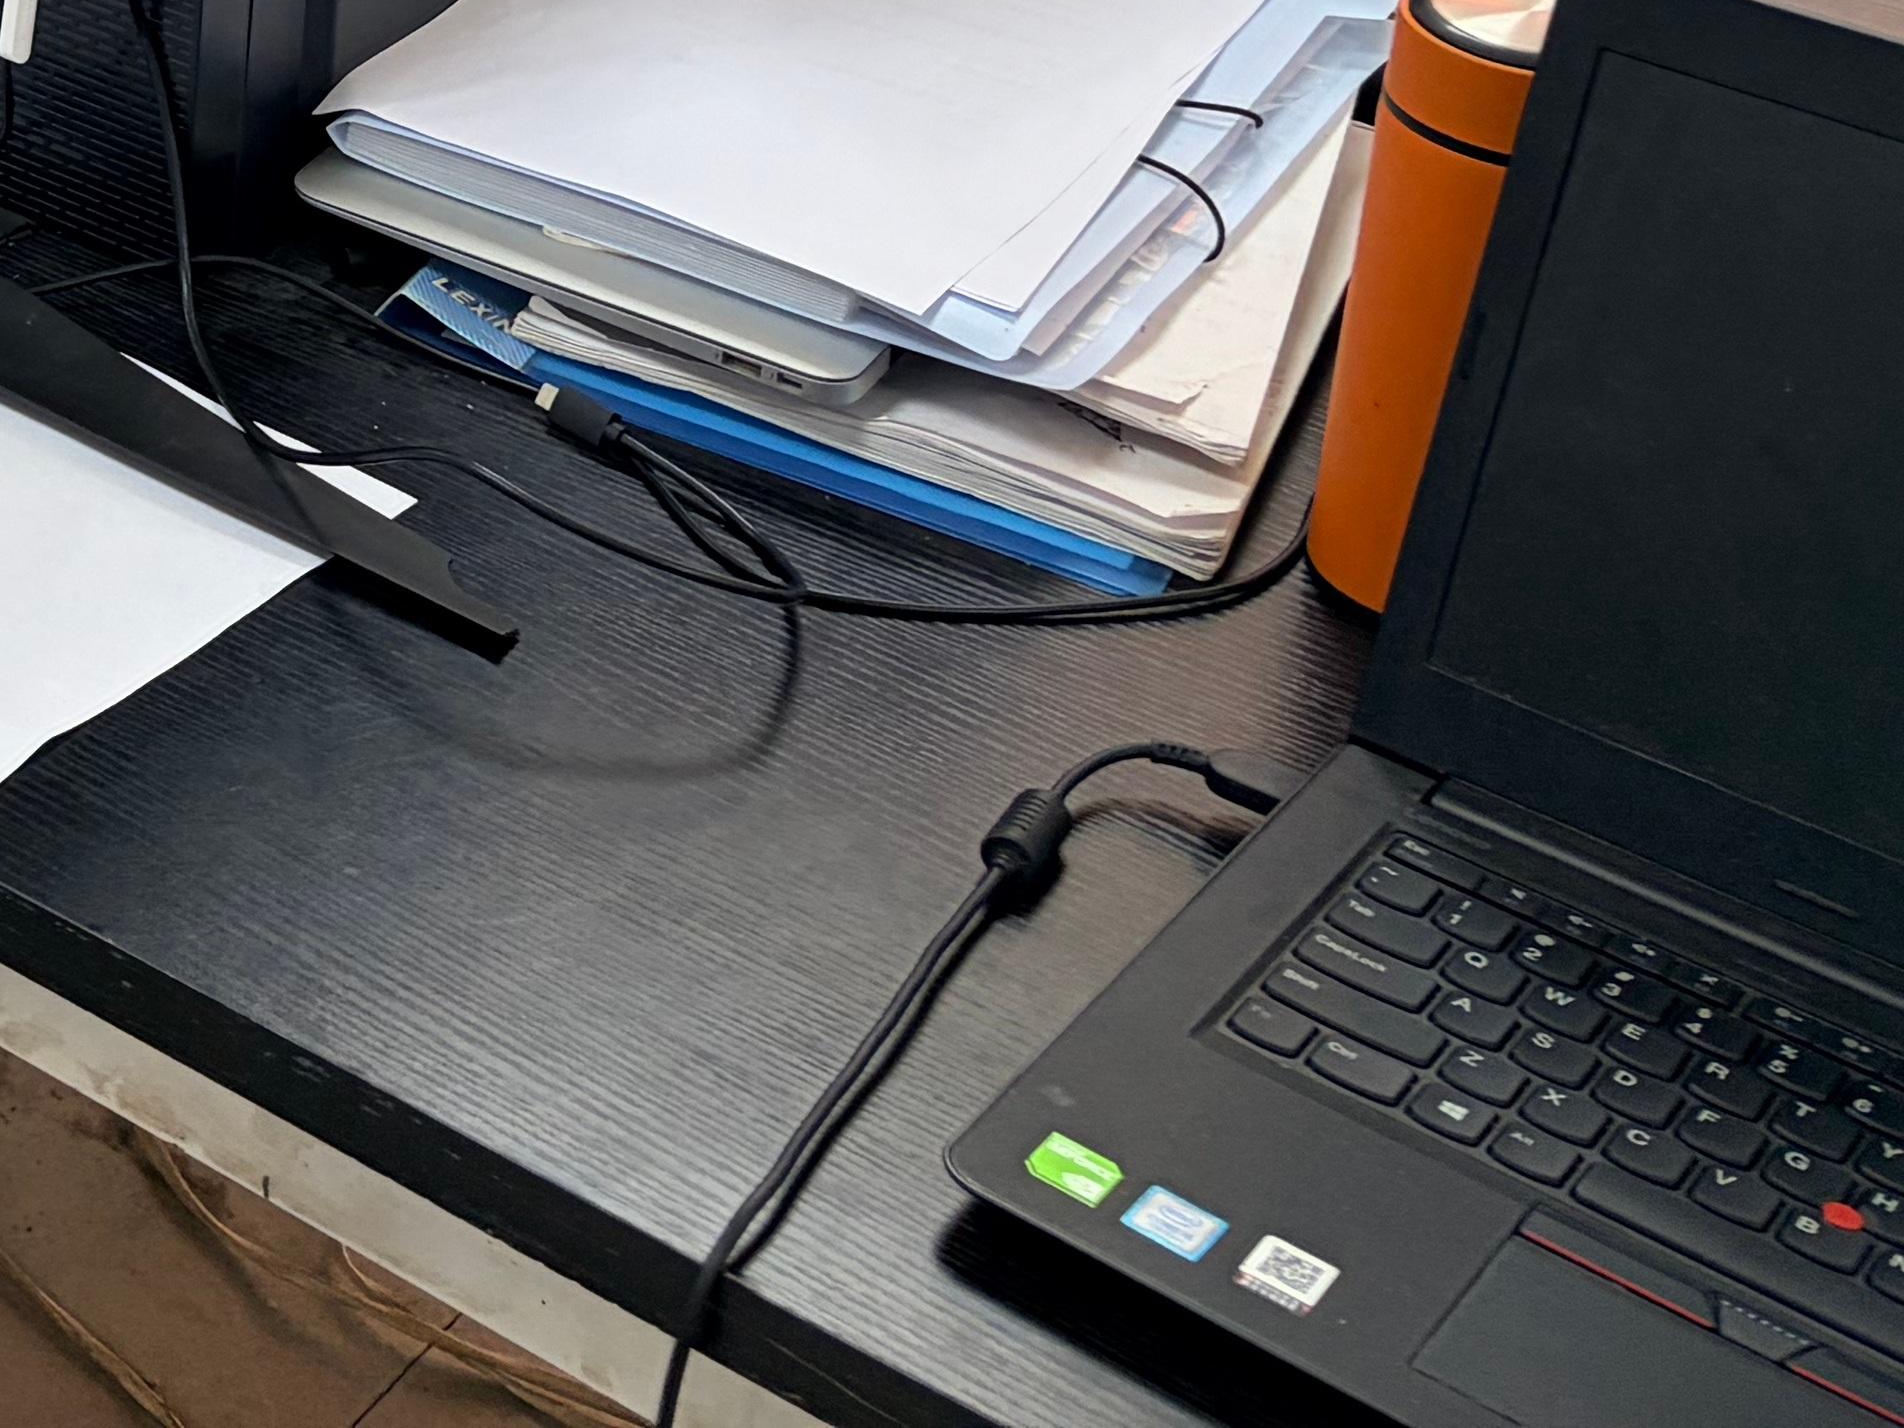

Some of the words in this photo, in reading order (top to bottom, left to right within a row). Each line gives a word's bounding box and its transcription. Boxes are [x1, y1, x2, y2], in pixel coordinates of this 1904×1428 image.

[1463, 951, 1489, 969] Q
[1522, 946, 1543, 961] 2
[1544, 986, 1577, 1006] W
[1600, 982, 1622, 997] 3
[1450, 997, 1472, 1013] A
[1531, 1031, 1556, 1049] S
[1620, 1023, 1647, 1041] E
[1459, 1049, 1485, 1068] Z
[1612, 1069, 1638, 1087] D
[1705, 1061, 1731, 1080] R
[1540, 1088, 1567, 1107] X
[1852, 1098, 1874, 1114] 6
[1696, 1109, 1722, 1124] F
[1794, 1101, 1817, 1118] T
[1625, 1129, 1652, 1146] C
[1881, 1143, 1904, 1159] Y
[1783, 1151, 1811, 1171] G
[1715, 1169, 1738, 1186] V
[1871, 1192, 1900, 1212] H
[1794, 1215, 1821, 1235] B
